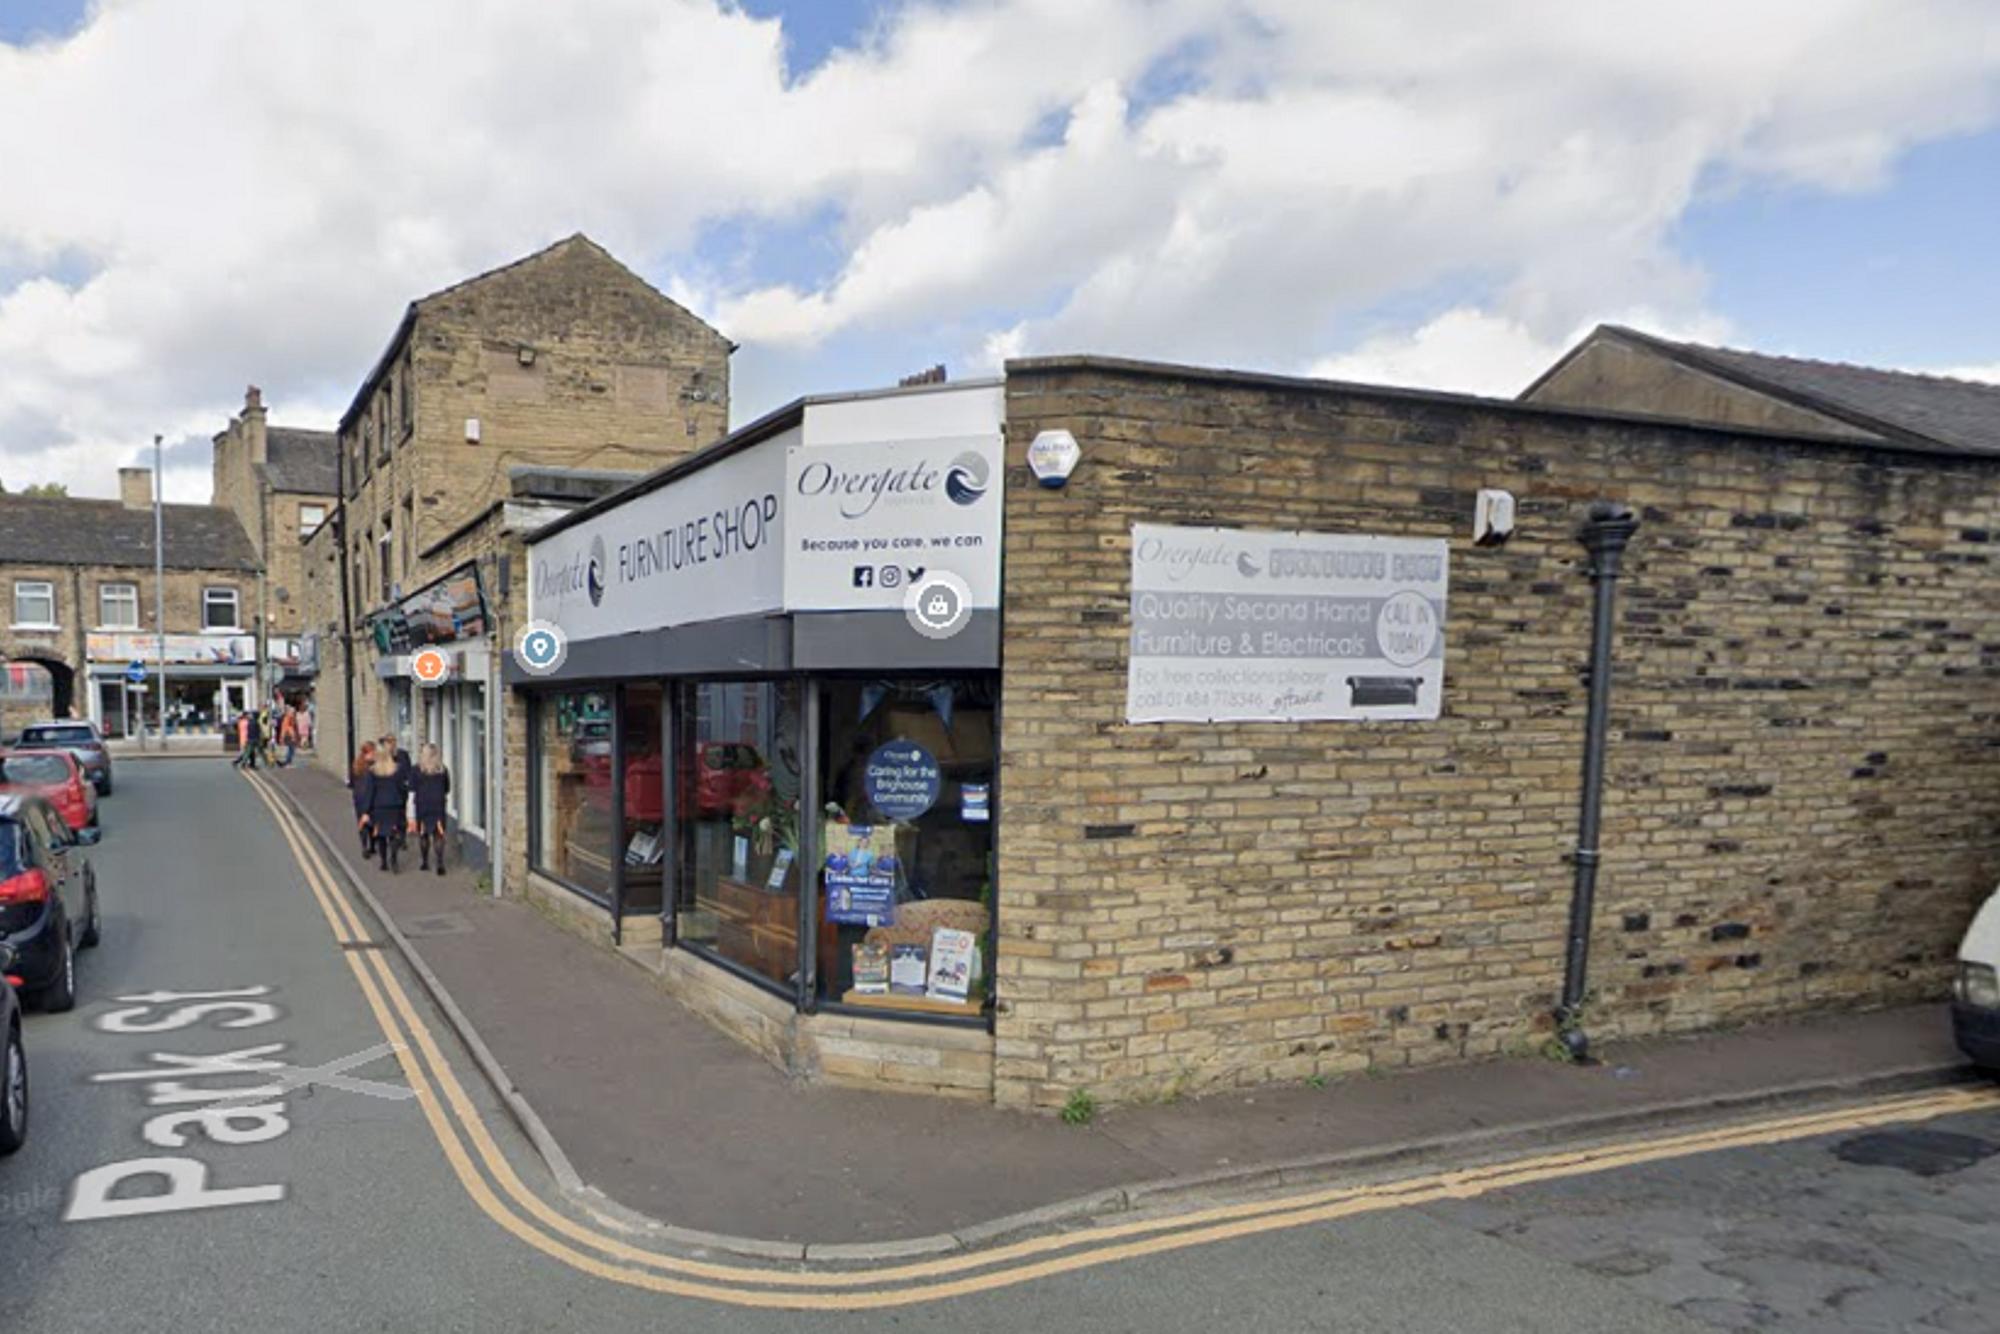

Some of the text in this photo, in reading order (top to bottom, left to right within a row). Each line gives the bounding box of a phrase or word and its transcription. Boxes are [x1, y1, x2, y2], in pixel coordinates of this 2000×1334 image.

[797, 460, 939, 519] Overgate
[620, 518, 708, 583] FURNITURE
[713, 494, 778, 558] SHOP
[802, 534, 983, 551] Because you care, we can
[1137, 538, 1233, 581] Overgate
[1139, 593, 1371, 624] Quality Second Hand
[1385, 601, 1410, 625] CALL
[1136, 629, 1367, 656] Furniture & Electricals
[1137, 667, 1154, 684] For
[1162, 666, 1195, 684] free
[1197, 666, 1275, 684] collections
[1135, 691, 1162, 707] call
[868, 764, 937, 780] Caring for the
[876, 779, 929, 793] Brighouse
[874, 792, 930, 805] community
